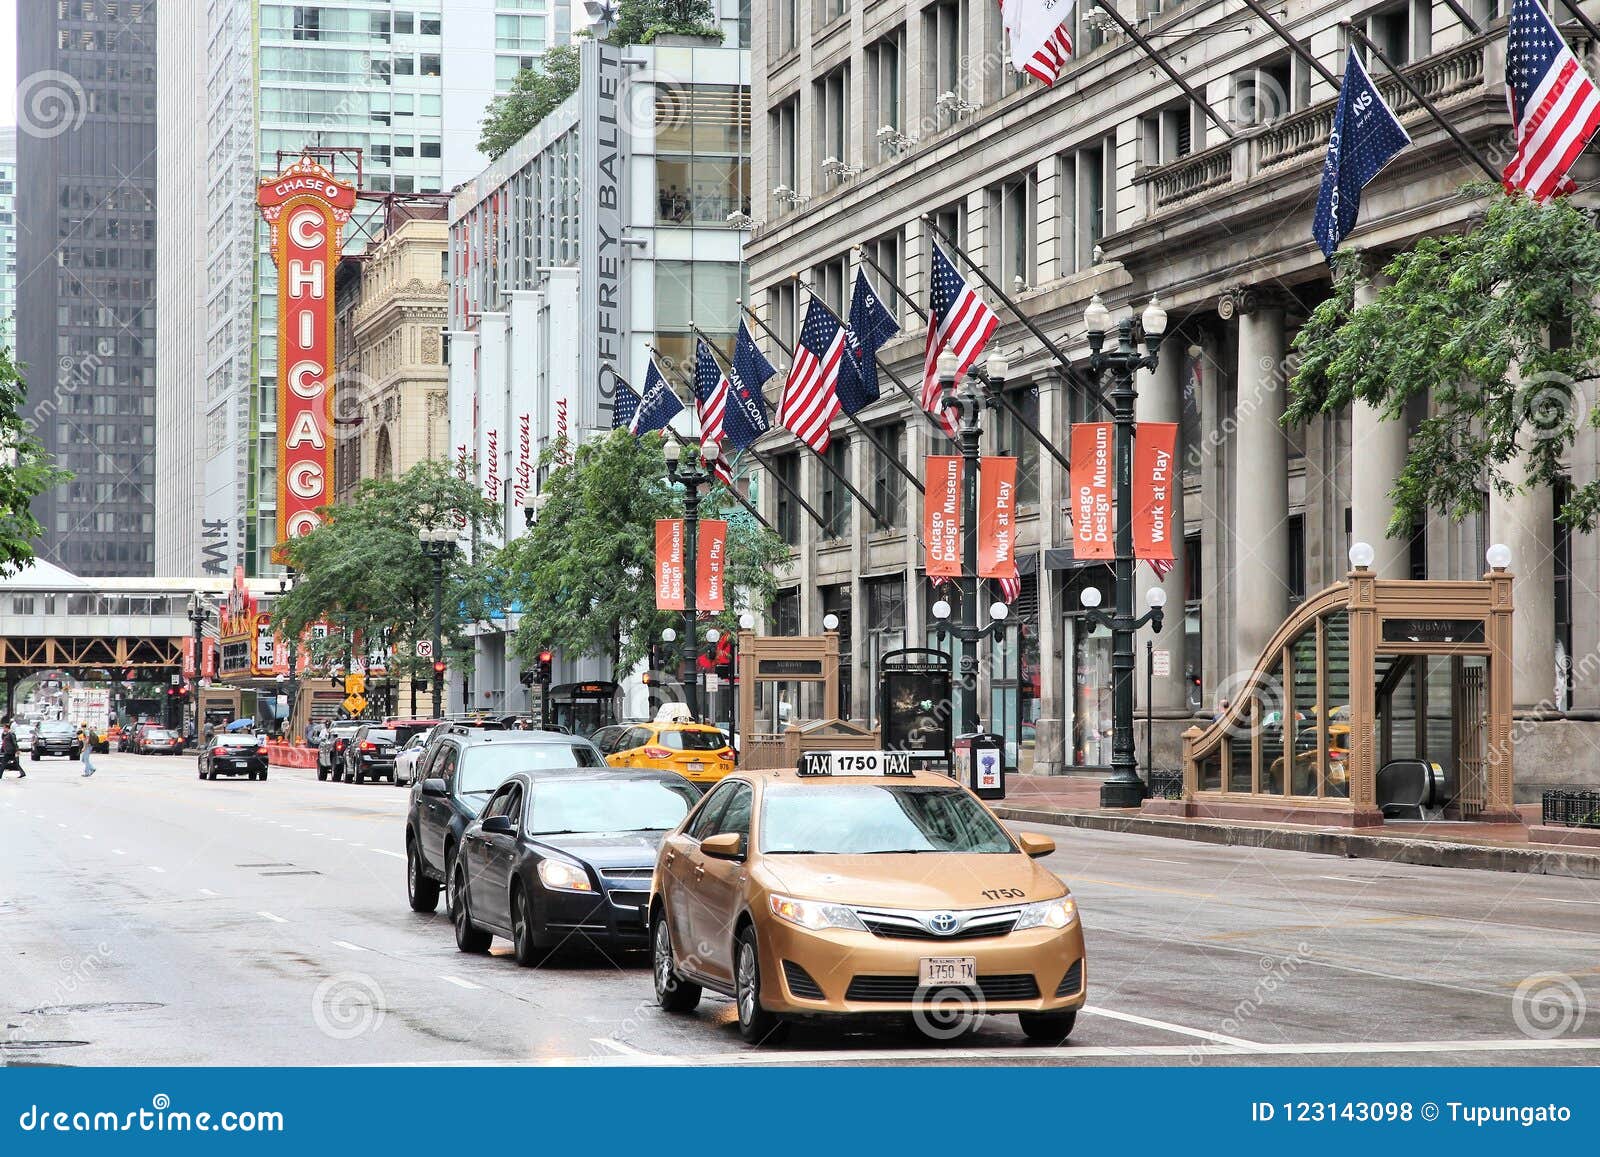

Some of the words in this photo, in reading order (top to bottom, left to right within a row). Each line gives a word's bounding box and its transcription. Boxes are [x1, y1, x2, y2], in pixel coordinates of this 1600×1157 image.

[599, 47, 617, 210] BALLET
[275, 179, 325, 196] CHASE
[286, 209, 325, 538] CHICAGO
[640, 379, 665, 406] ICONS
[744, 398, 766, 431] ICONS
[513, 412, 535, 507] Walgreens
[1092, 427, 1107, 488] Museum
[1152, 450, 1171, 482] Play
[943, 460, 958, 514] Museum
[996, 481, 1013, 509] Play
[1152, 486, 1165, 501] at
[997, 513, 1009, 526] at
[1078, 486, 1094, 542] Chicago
[1093, 494, 1110, 542] Design
[1151, 505, 1165, 543] Work
[670, 522, 680, 563] Museum
[710, 537, 723, 560] Play
[930, 511, 944, 561] Chicago
[943, 519, 958, 562] Design
[995, 530, 1009, 563] Work
[660, 561, 672, 599] Chicago
[671, 566, 682, 599] Design
[710, 562, 719, 572] at
[708, 575, 719, 600] Work
[805, 756, 832, 774] TAXI
[838, 756, 877, 771] 1750
[882, 755, 910, 774] TAXI
[981, 888, 1025, 900] 1750
[929, 964, 955, 979] 1750
[960, 964, 973, 979] TX
